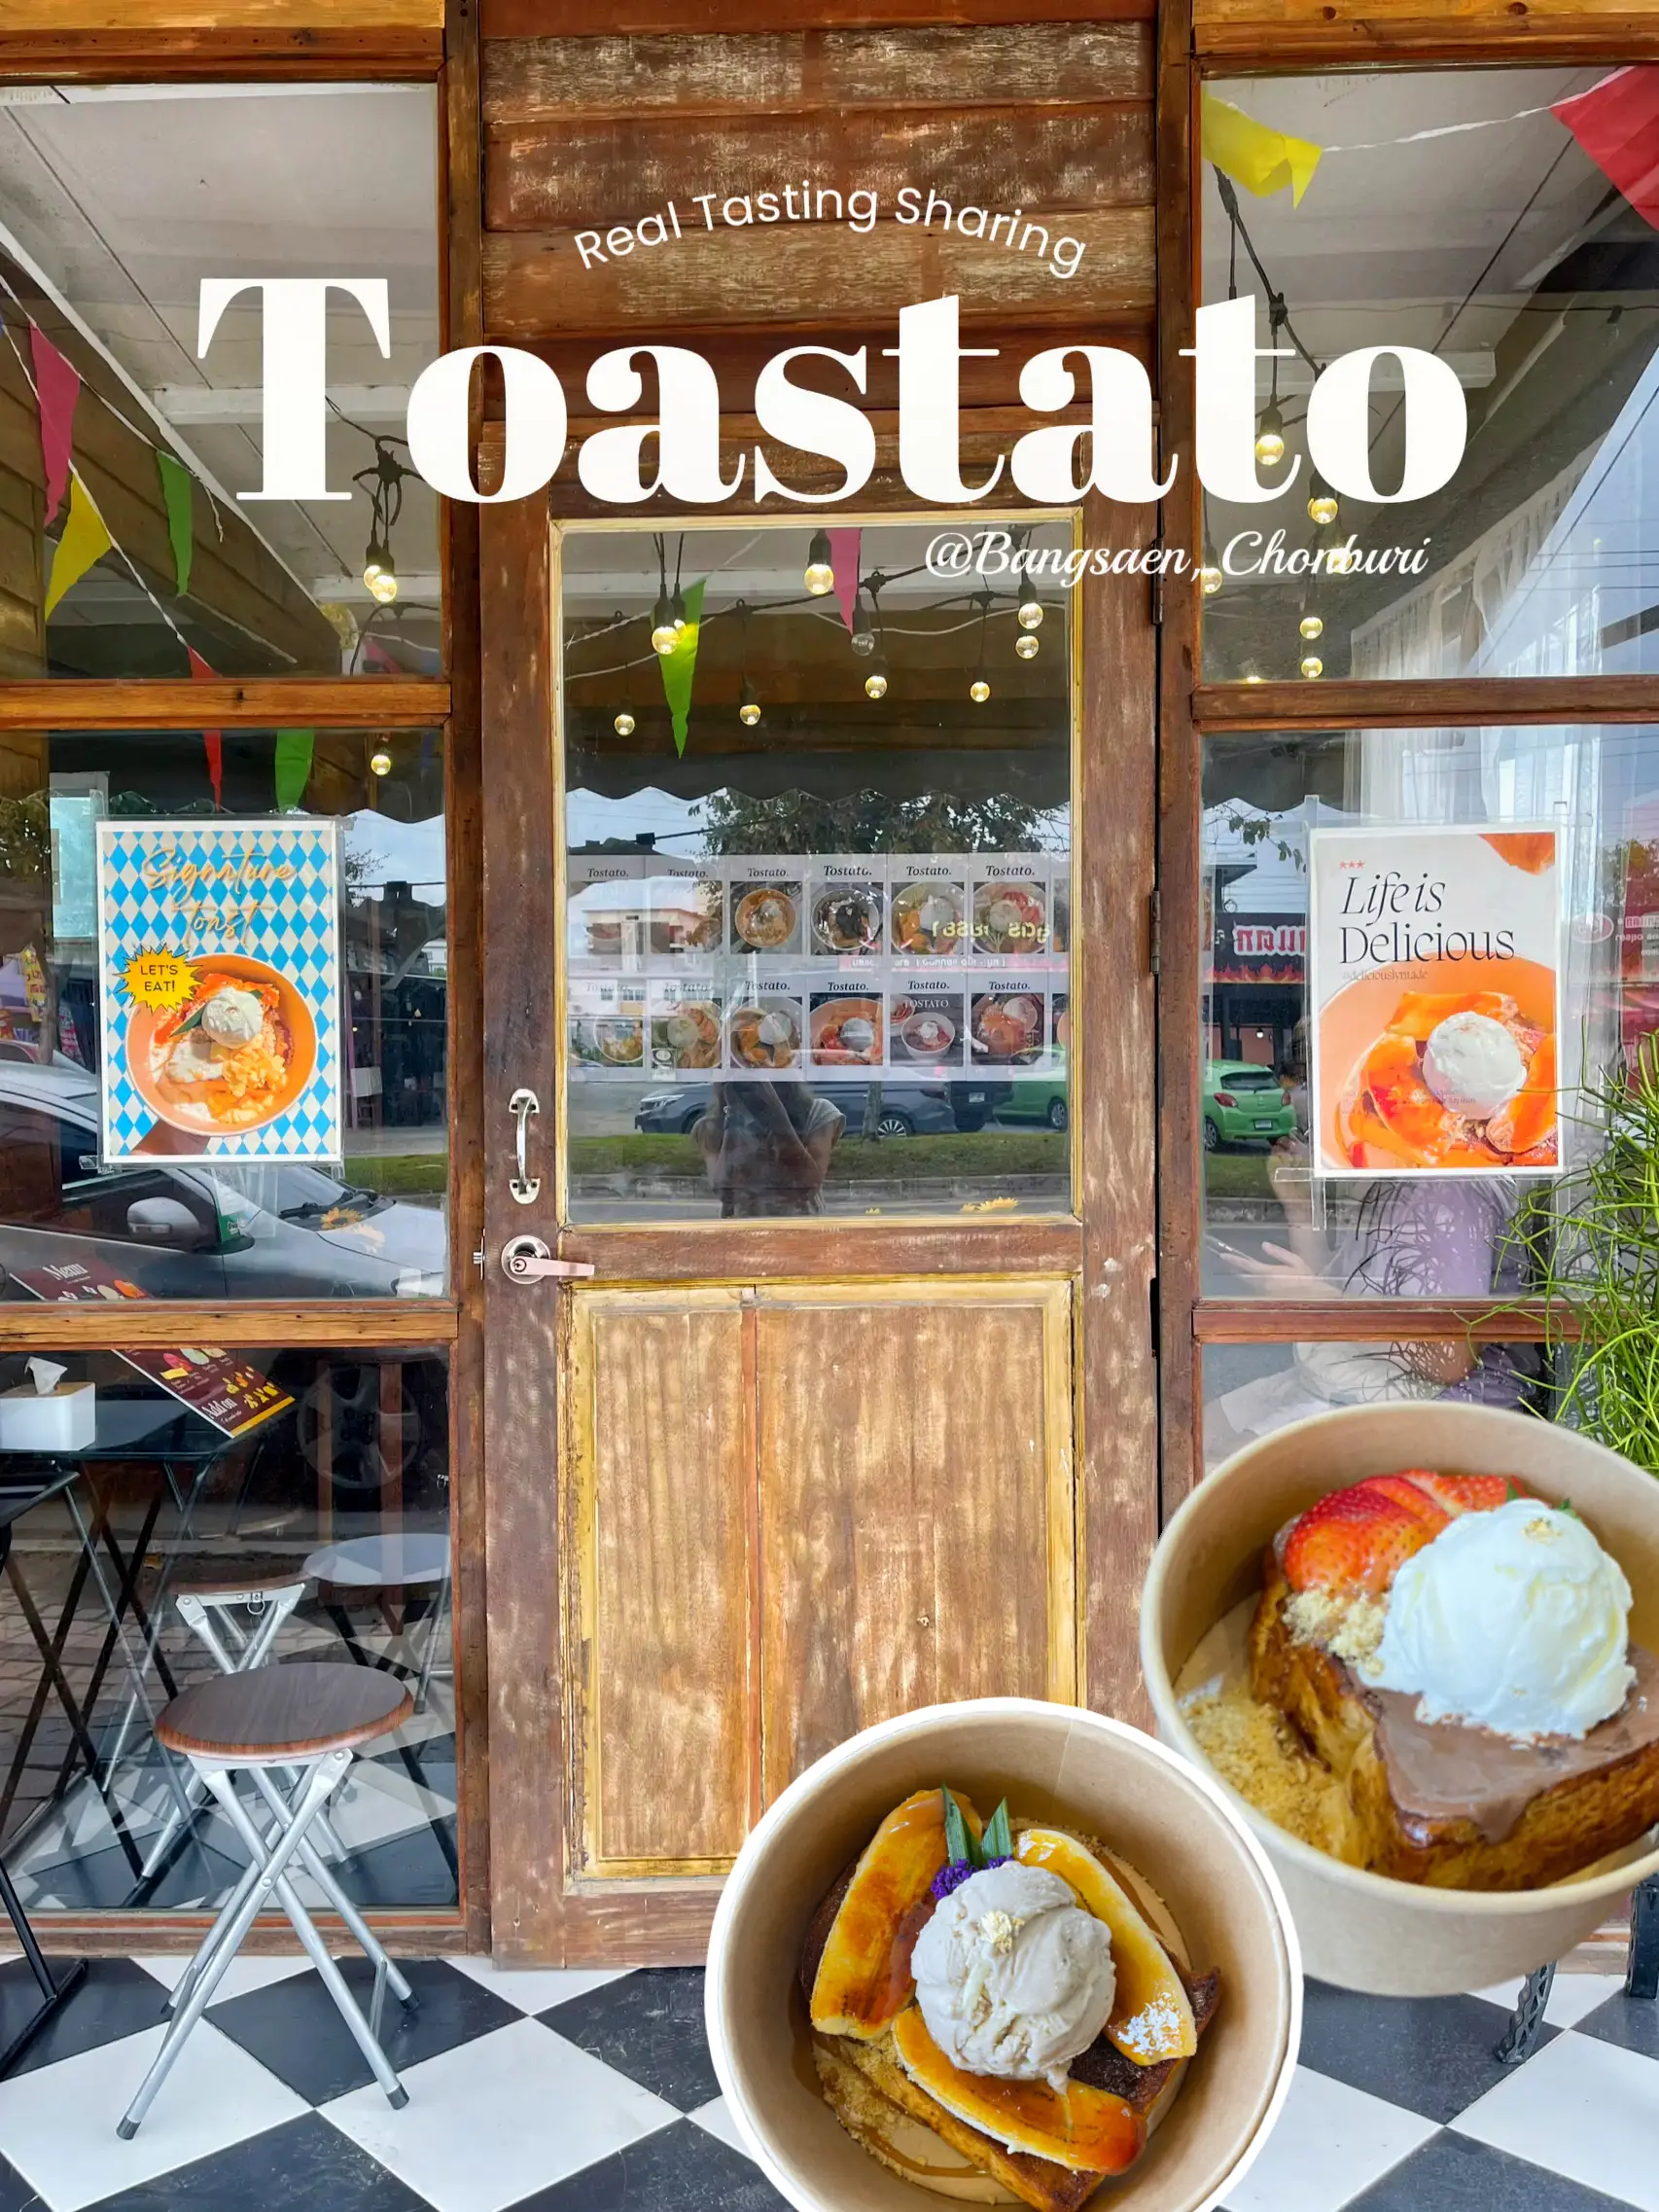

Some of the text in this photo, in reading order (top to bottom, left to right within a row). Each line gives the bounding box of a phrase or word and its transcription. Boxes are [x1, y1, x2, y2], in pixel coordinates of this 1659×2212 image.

[587, 867, 629, 877] Tostato.
[667, 868, 709, 878] Tostato.
[747, 867, 790, 877] Tostato.
[824, 865, 872, 876] Tostato.
[906, 865, 952, 876] Tostato.
[985, 865, 1035, 876] Tostato.
[141, 847, 298, 908] Signature
[1339, 872, 1446, 927] Life is
[1339, 922, 1515, 964] Delicious
[140, 965, 178, 976] LET'S
[144, 981, 175, 991] EAT!
[745, 981, 791, 990] Tostato.
[828, 981, 869, 991] Tostato.
[907, 980, 950, 990] Tostato.
[989, 981, 1031, 990] Tostato.
[42, 1263, 88, 1281] Menu
[201, 1400, 228, 1419] Add
[221, 1397, 238, 1409] on
